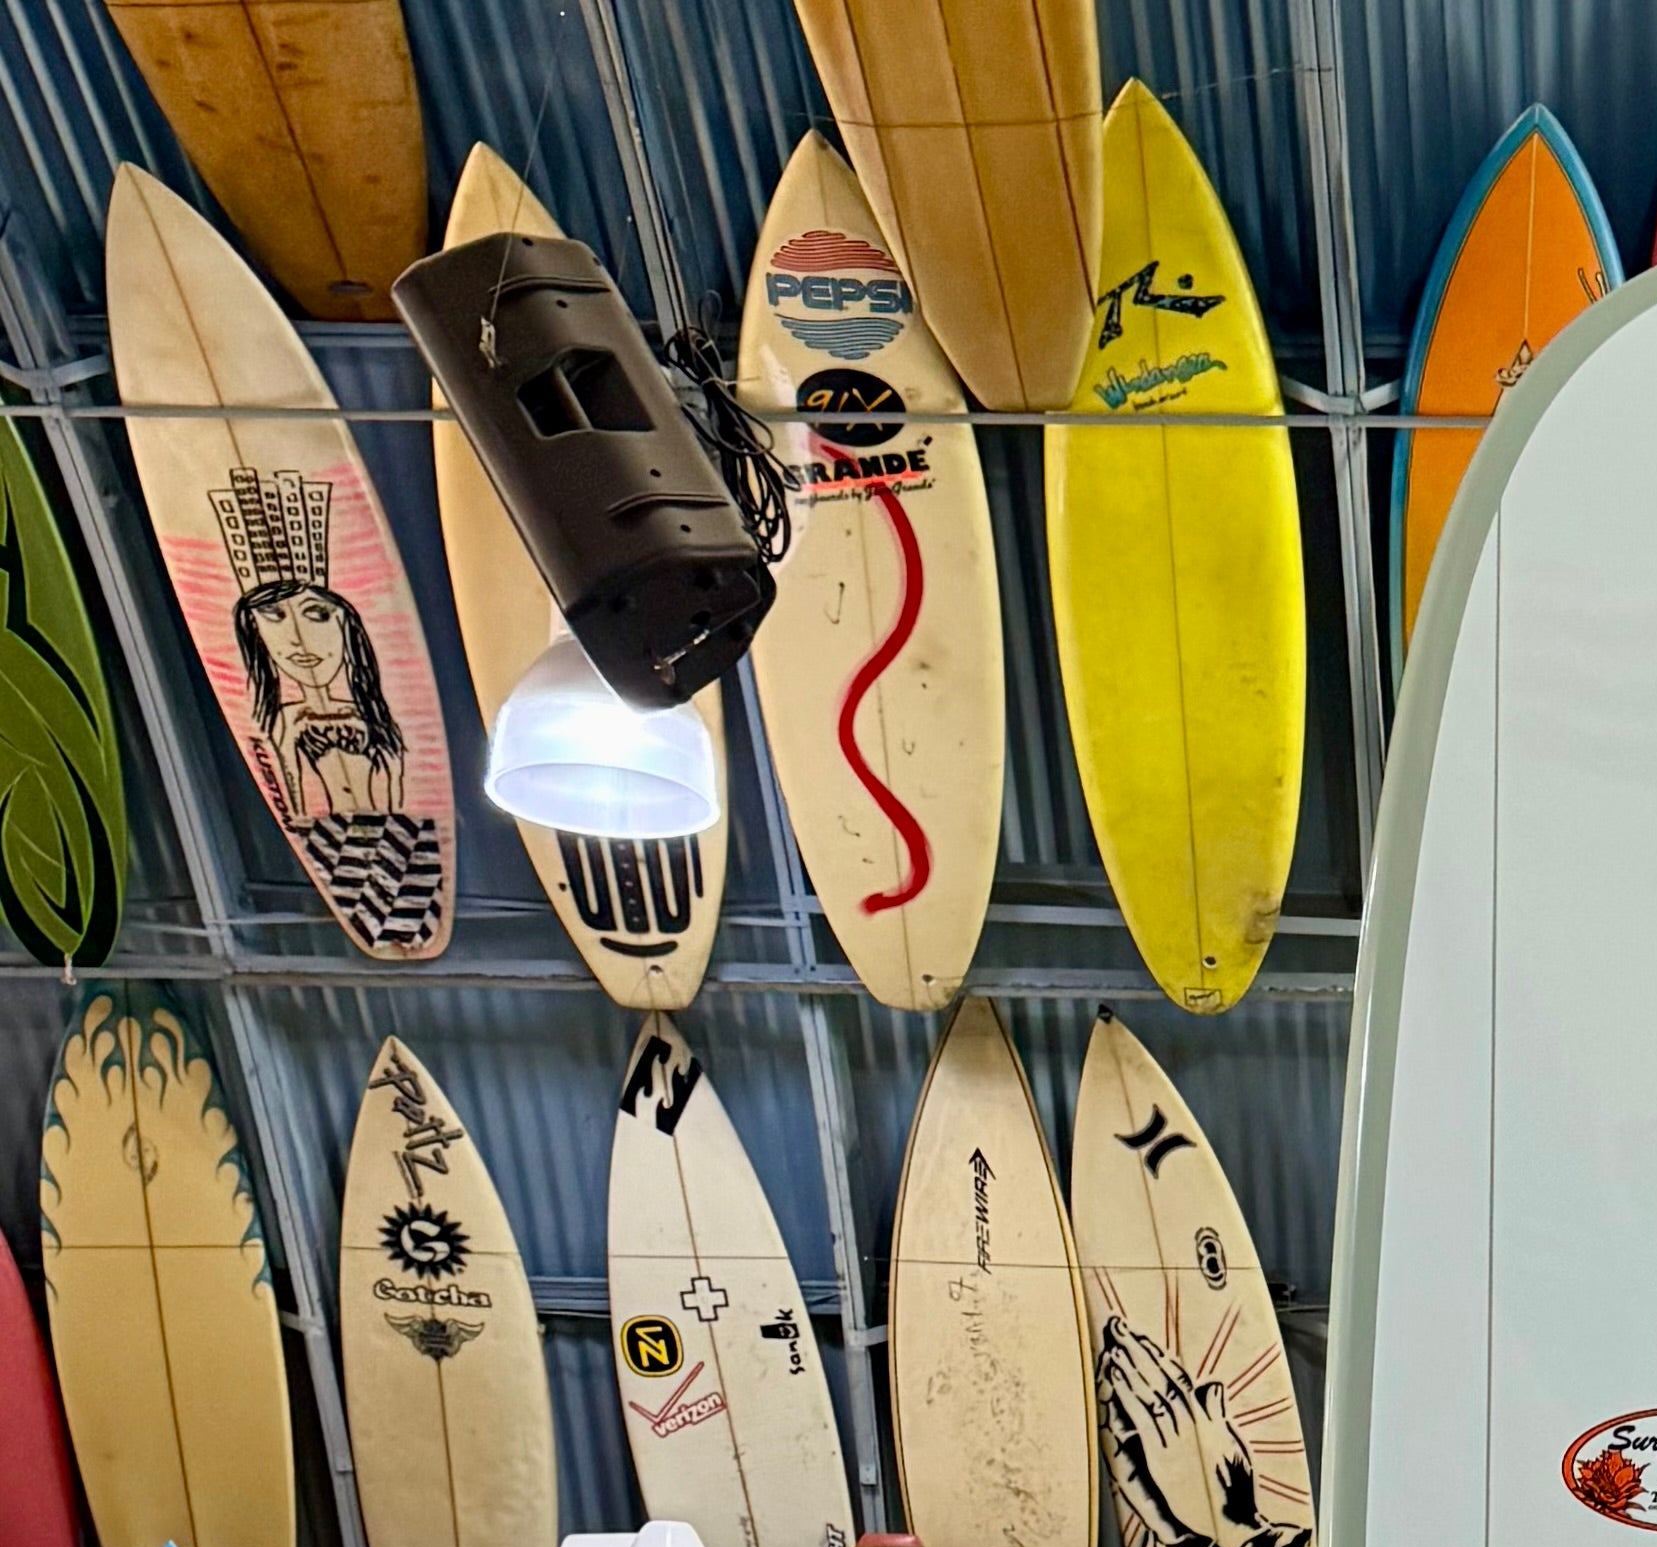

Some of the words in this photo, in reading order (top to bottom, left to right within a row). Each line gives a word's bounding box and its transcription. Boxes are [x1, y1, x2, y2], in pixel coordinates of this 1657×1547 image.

[766, 272, 913, 314] PEPSI
[249, 736, 299, 834] KUSTOM
[970, 1148, 997, 1275] FIREWIRE
[372, 1277, 492, 1308] Gotcha
[653, 1391, 728, 1438] verizon
